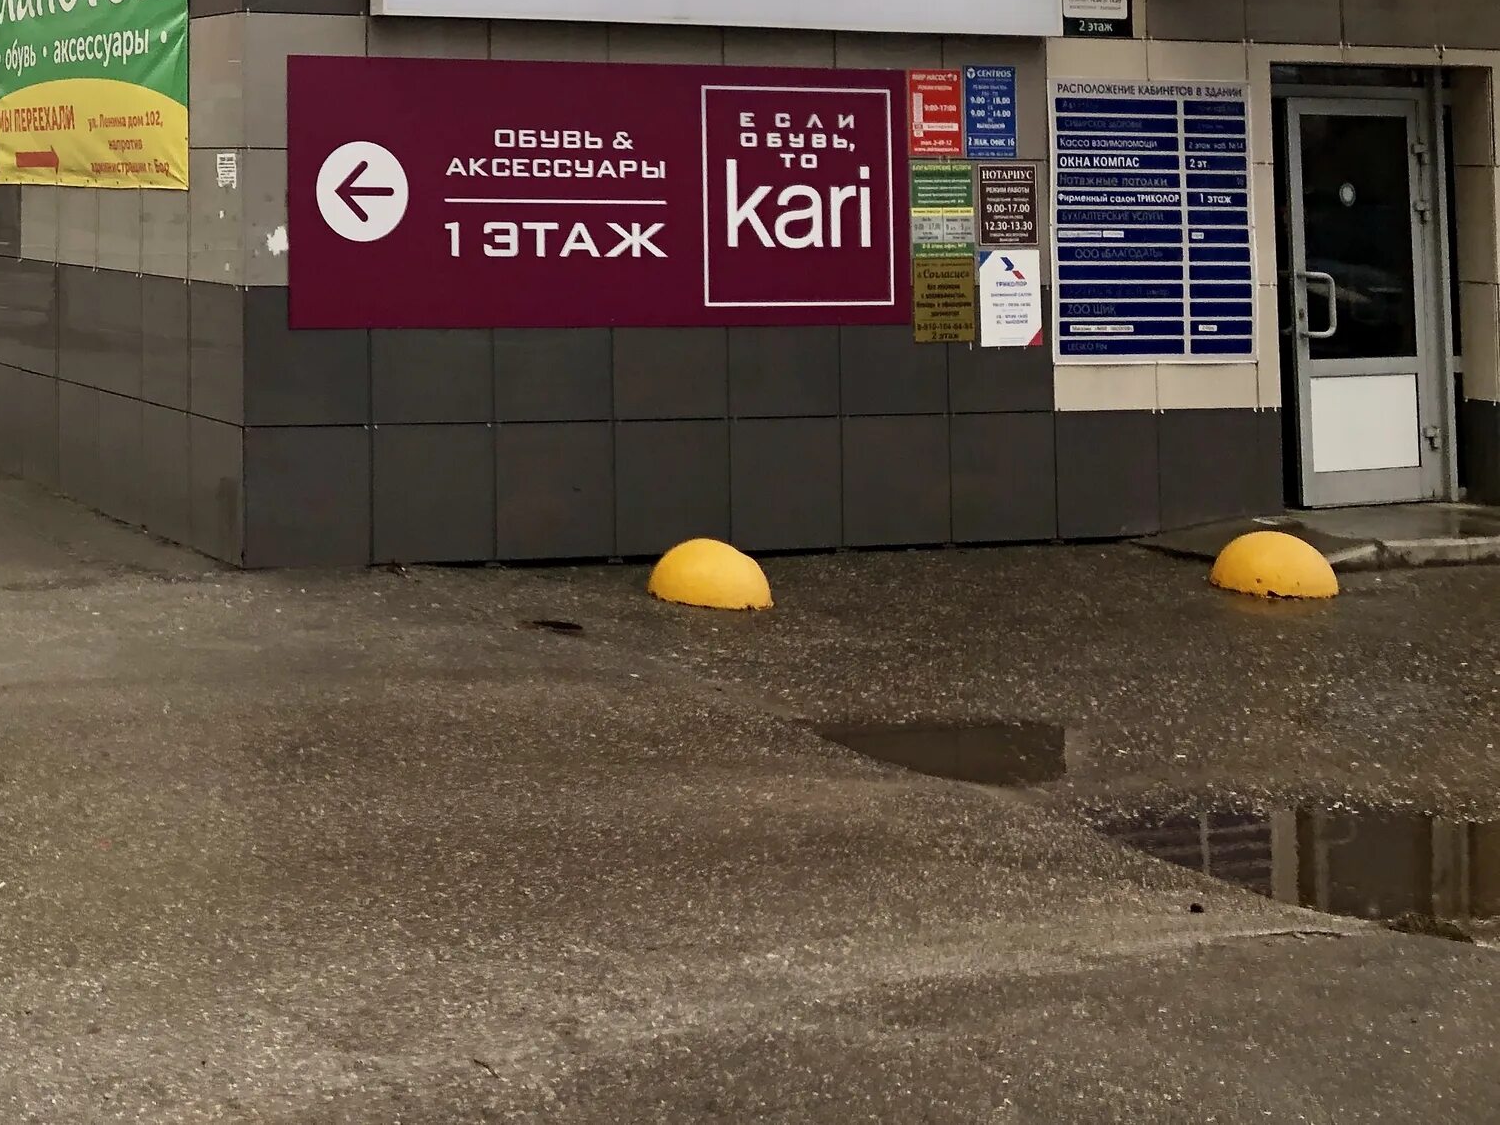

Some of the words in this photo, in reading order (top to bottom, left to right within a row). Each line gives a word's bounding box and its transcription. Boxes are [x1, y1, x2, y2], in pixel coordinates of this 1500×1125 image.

[1079, 20, 1086, 31] 2
[1088, 23, 1113, 32] этаж
[5, 39, 36, 77] обувь
[54, 29, 149, 68] аксессуары
[977, 69, 1012, 78] CENTROS
[1057, 84, 1135, 95] РАСПОЛОЖЕНИЕ
[1137, 85, 1193, 96] КАБИНЕТОВ
[1196, 87, 1201, 96] В
[1204, 87, 1242, 98] ЗДАНИИ
[14, 105, 75, 133] ПЕРЕЕХАЛИ
[128, 115, 144, 129] дом
[740, 112, 856, 128] ЕСЛИ
[494, 128, 603, 150] ОБУВЬ
[613, 131, 633, 150] &
[740, 132, 856, 153] ОБУВЬ,
[1060, 138, 1090, 147] Касса
[1092, 140, 1157, 150] взаимопомощи
[108, 139, 143, 153] напротив
[781, 154, 818, 169] ТО
[1060, 157, 1091, 167] ОКНА
[1093, 157, 1140, 167] КОМПАС
[1190, 159, 1195, 168] 2
[445, 157, 667, 180] АКСЕССУАРЫ
[982, 170, 1033, 179] НОТАРИУС
[1059, 174, 1118, 186] Натяжные
[1121, 177, 1168, 186] потолки
[725, 158, 873, 249] kari
[1058, 192, 1108, 203] Фирменный
[1109, 195, 1136, 203] салон
[1137, 194, 1180, 203] ТРИКОЛОР
[1207, 195, 1232, 203] этаж
[986, 204, 1030, 213] 9.00-17.00
[985, 221, 1033, 231] 12.30-13.30
[444, 222, 460, 257] 1
[483, 222, 669, 258] ЭТАЖ
[1075, 249, 1099, 258] ООО
